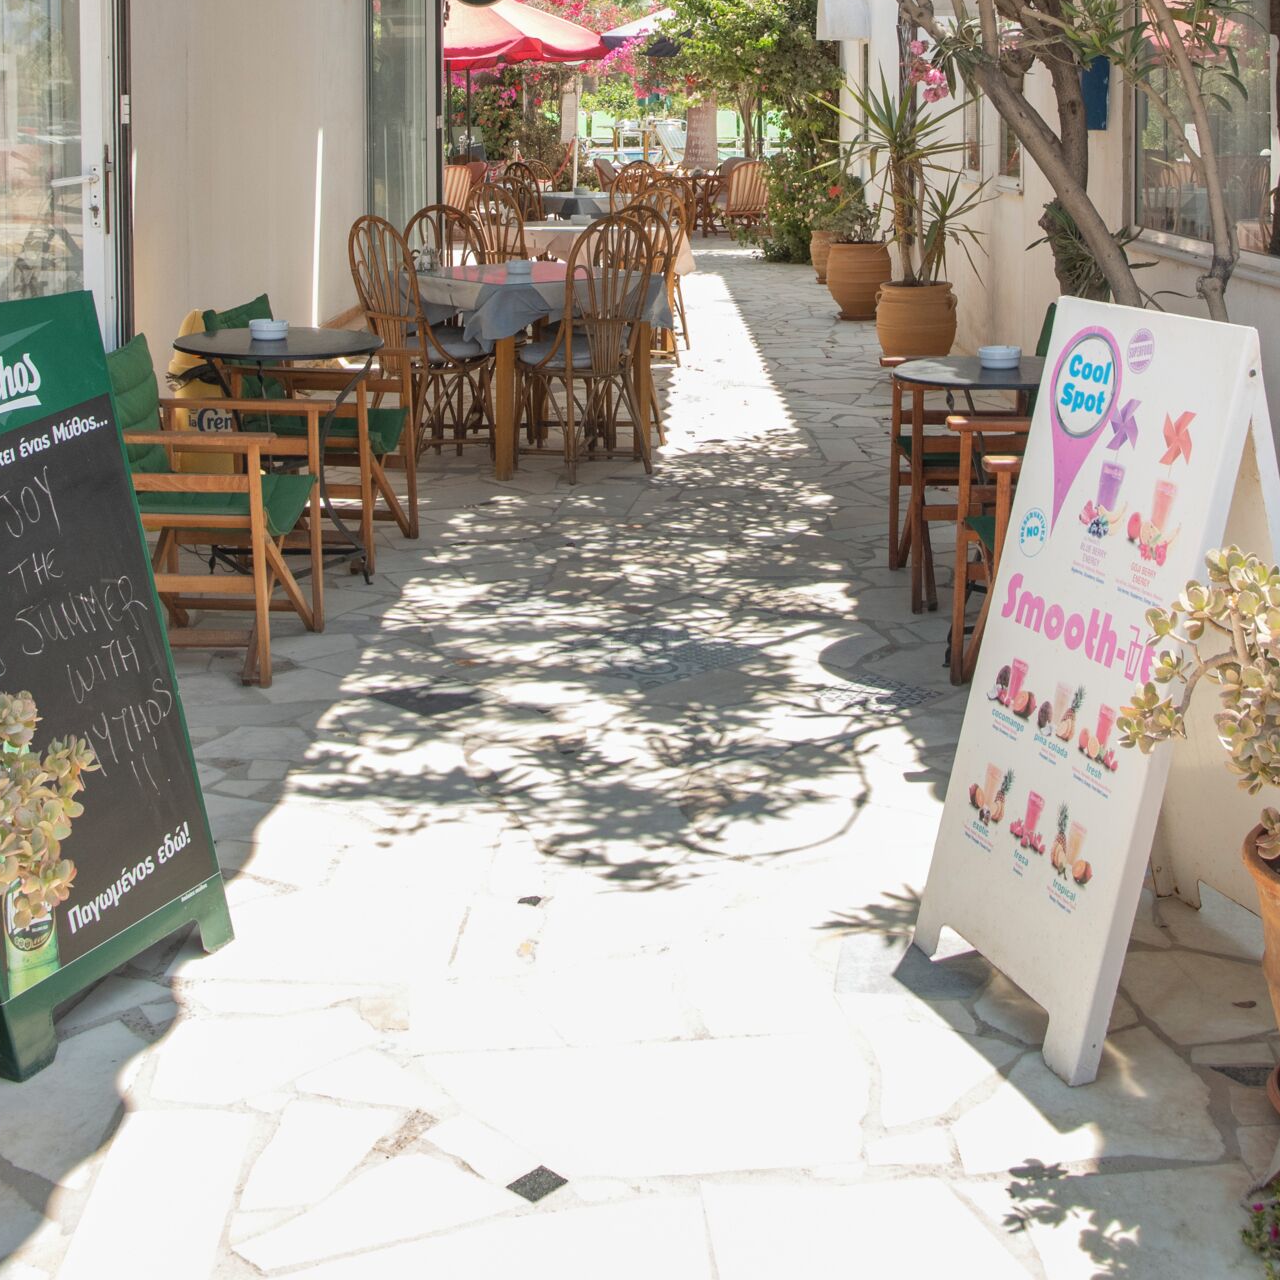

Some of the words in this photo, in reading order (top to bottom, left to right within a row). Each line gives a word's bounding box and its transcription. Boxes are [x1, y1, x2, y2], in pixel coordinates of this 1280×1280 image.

[1068, 354, 1112, 385] Cool
[1060, 382, 1105, 415] Spot
[19, 433, 51, 458] ένας
[1026, 526, 1039, 537] NO
[8, 548, 64, 593] THE
[14, 575, 148, 656] SUMMER
[66, 635, 140, 704] WITH
[992, 708, 1025, 732] cocomango
[1047, 741, 1068, 759] colada
[1086, 763, 1102, 779] fresh
[972, 820, 989, 837] exotic
[1013, 849, 1029, 866] fresa
[68, 856, 155, 934] Παγωμένος
[157, 821, 192, 869] εδώ!
[1052, 879, 1076, 902] tropical
